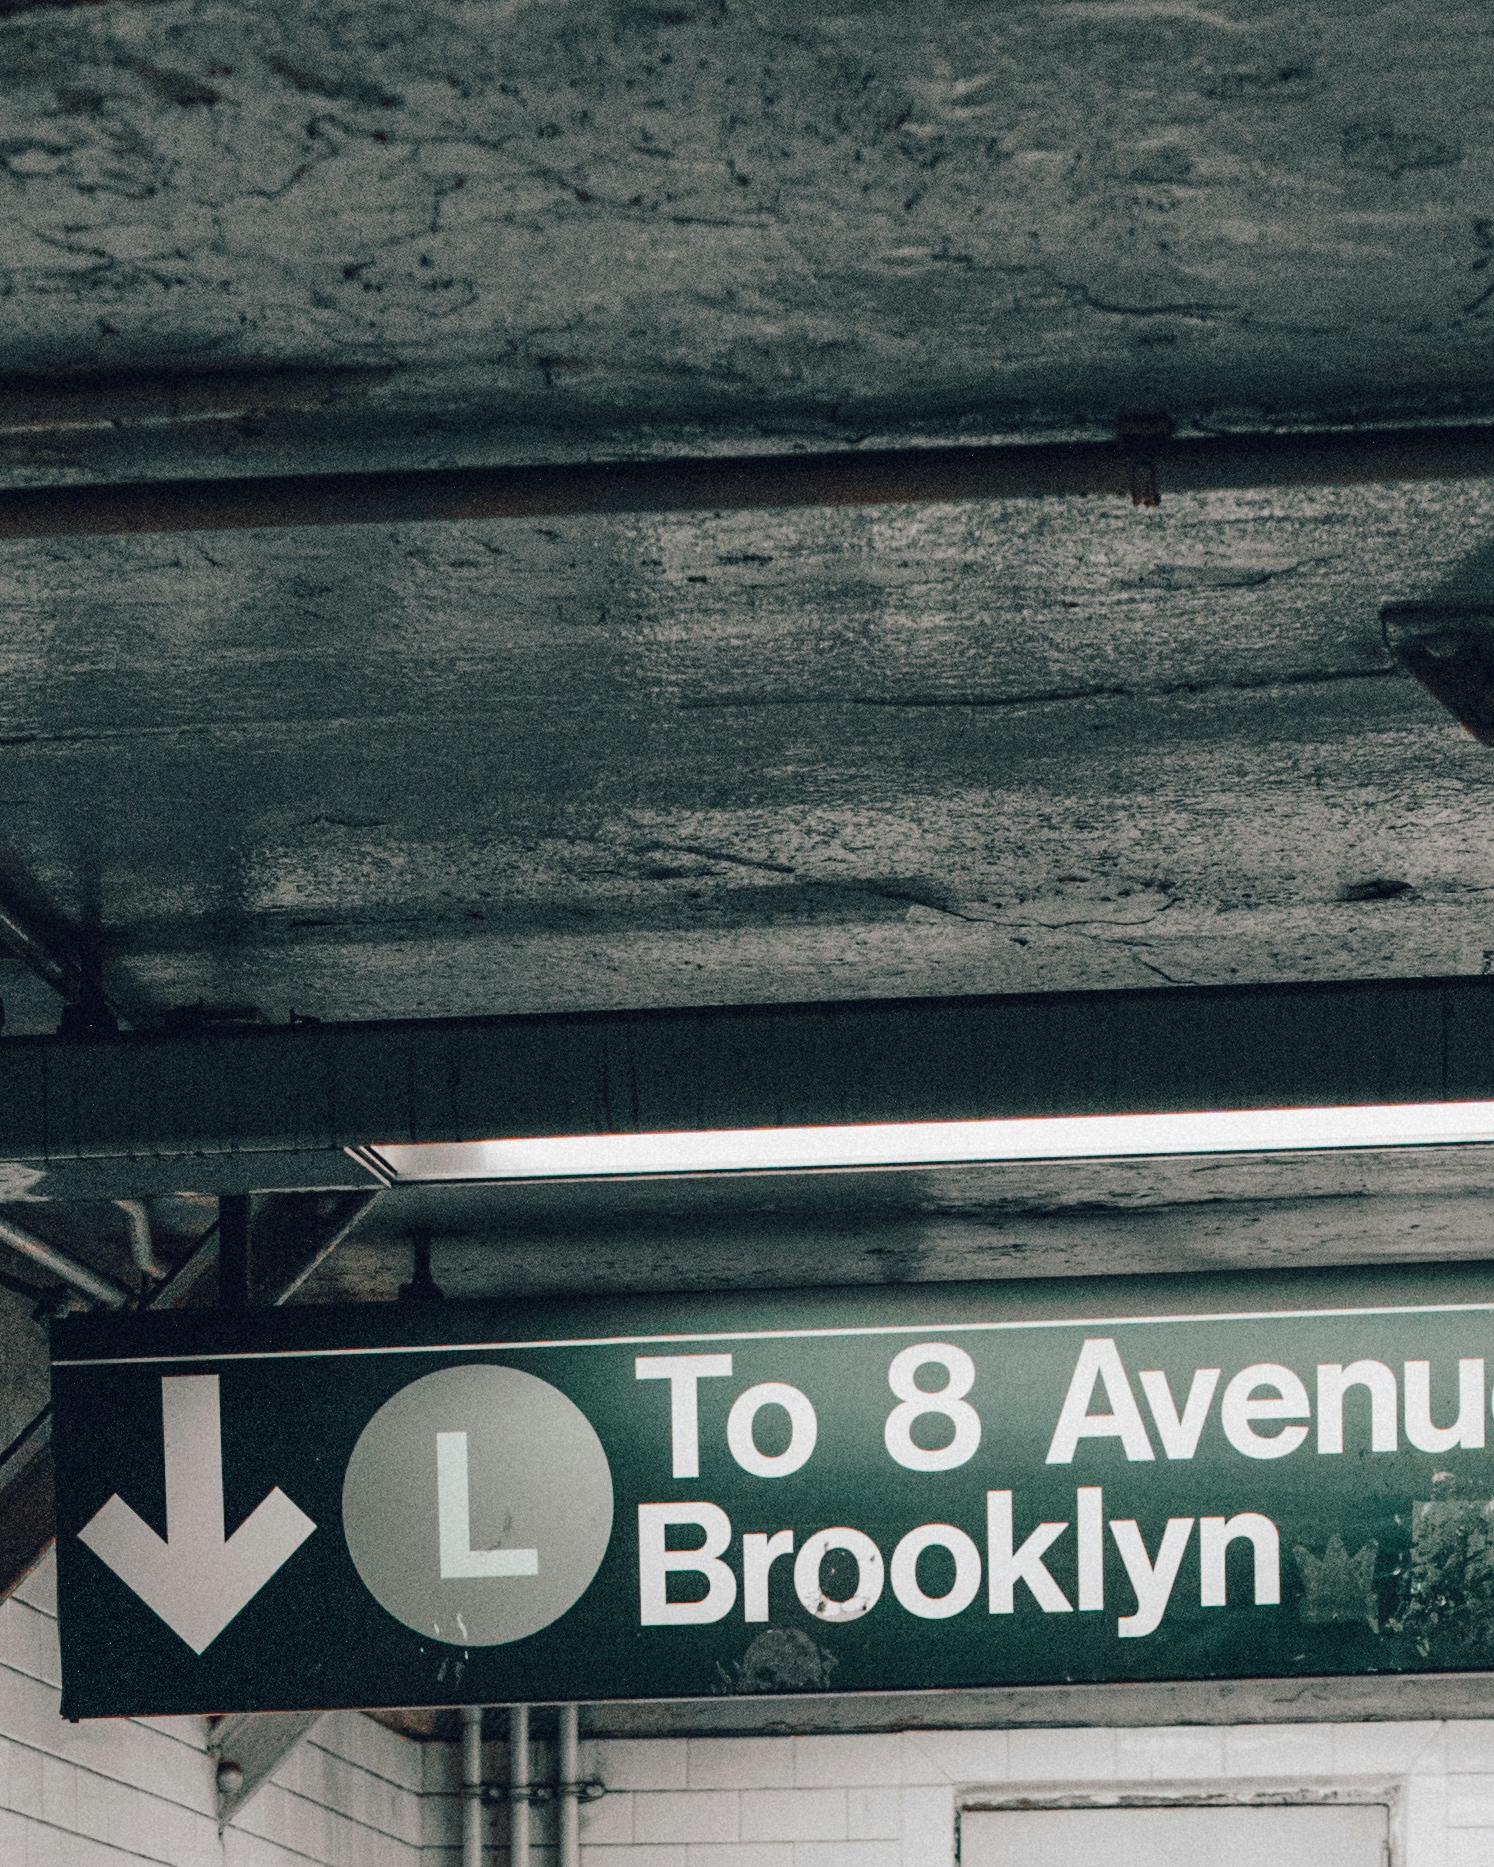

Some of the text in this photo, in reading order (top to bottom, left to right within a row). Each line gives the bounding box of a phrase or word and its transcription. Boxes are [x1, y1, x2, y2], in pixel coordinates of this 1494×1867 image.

[636, 1354, 822, 1477] To
[884, 1342, 981, 1471] 8
[436, 1431, 539, 1578] L
[640, 1487, 1279, 1636] Brooklyn
